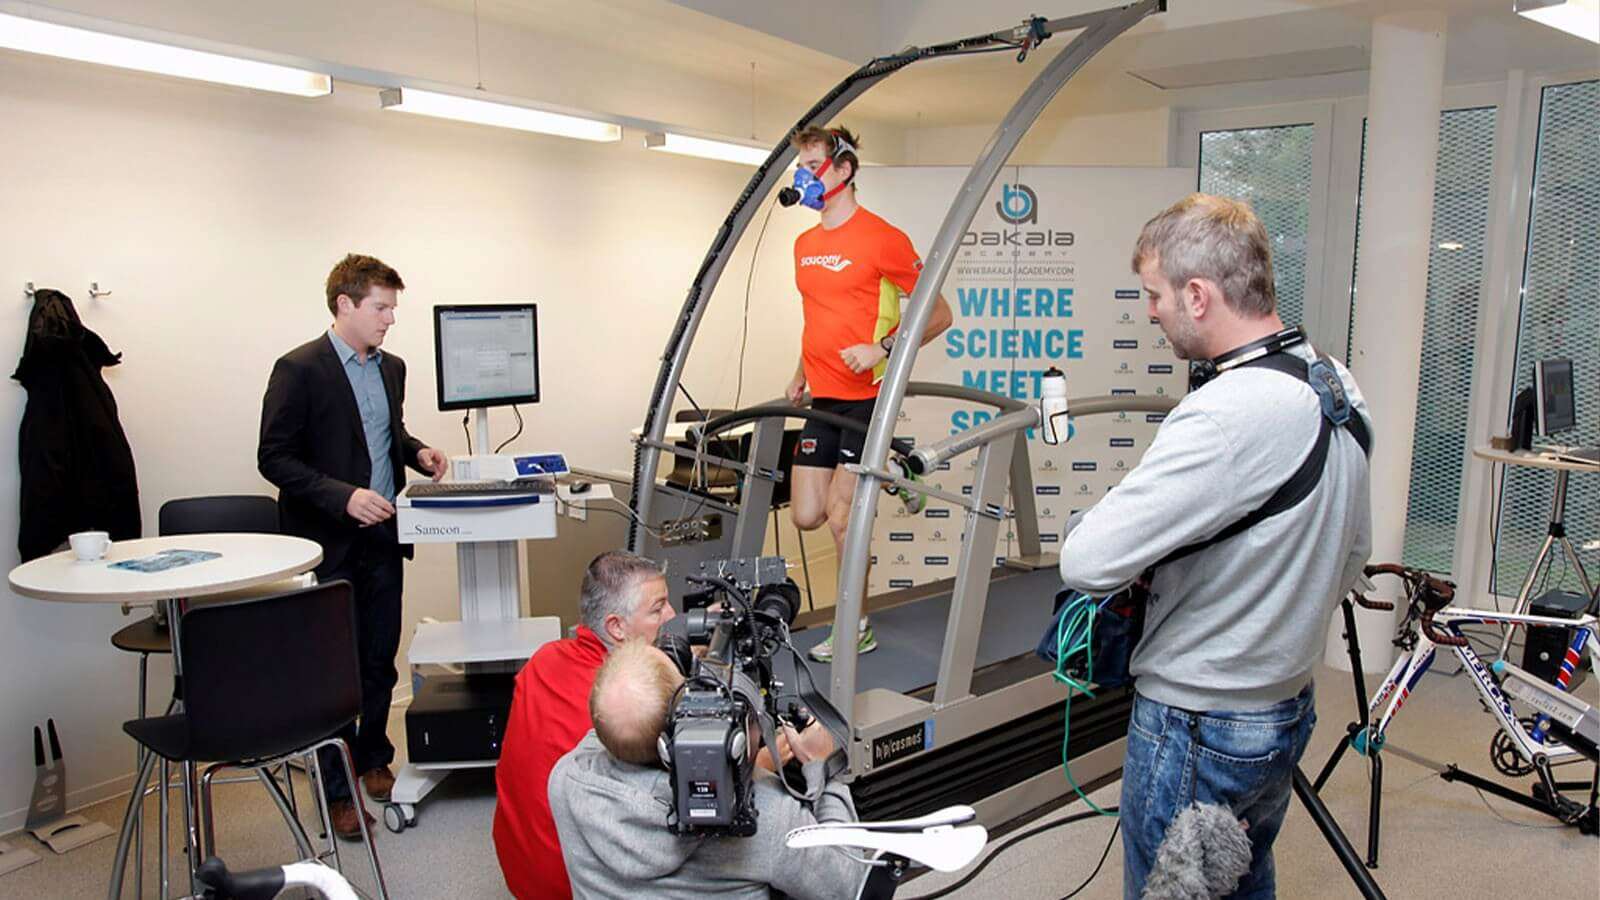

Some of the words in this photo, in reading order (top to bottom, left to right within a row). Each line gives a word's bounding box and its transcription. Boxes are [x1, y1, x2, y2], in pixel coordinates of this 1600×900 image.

[800, 254, 842, 268] saucony
[957, 287, 1074, 317] WHERE
[946, 329, 1084, 359] SCIENCE
[414, 524, 461, 536] Samcon
